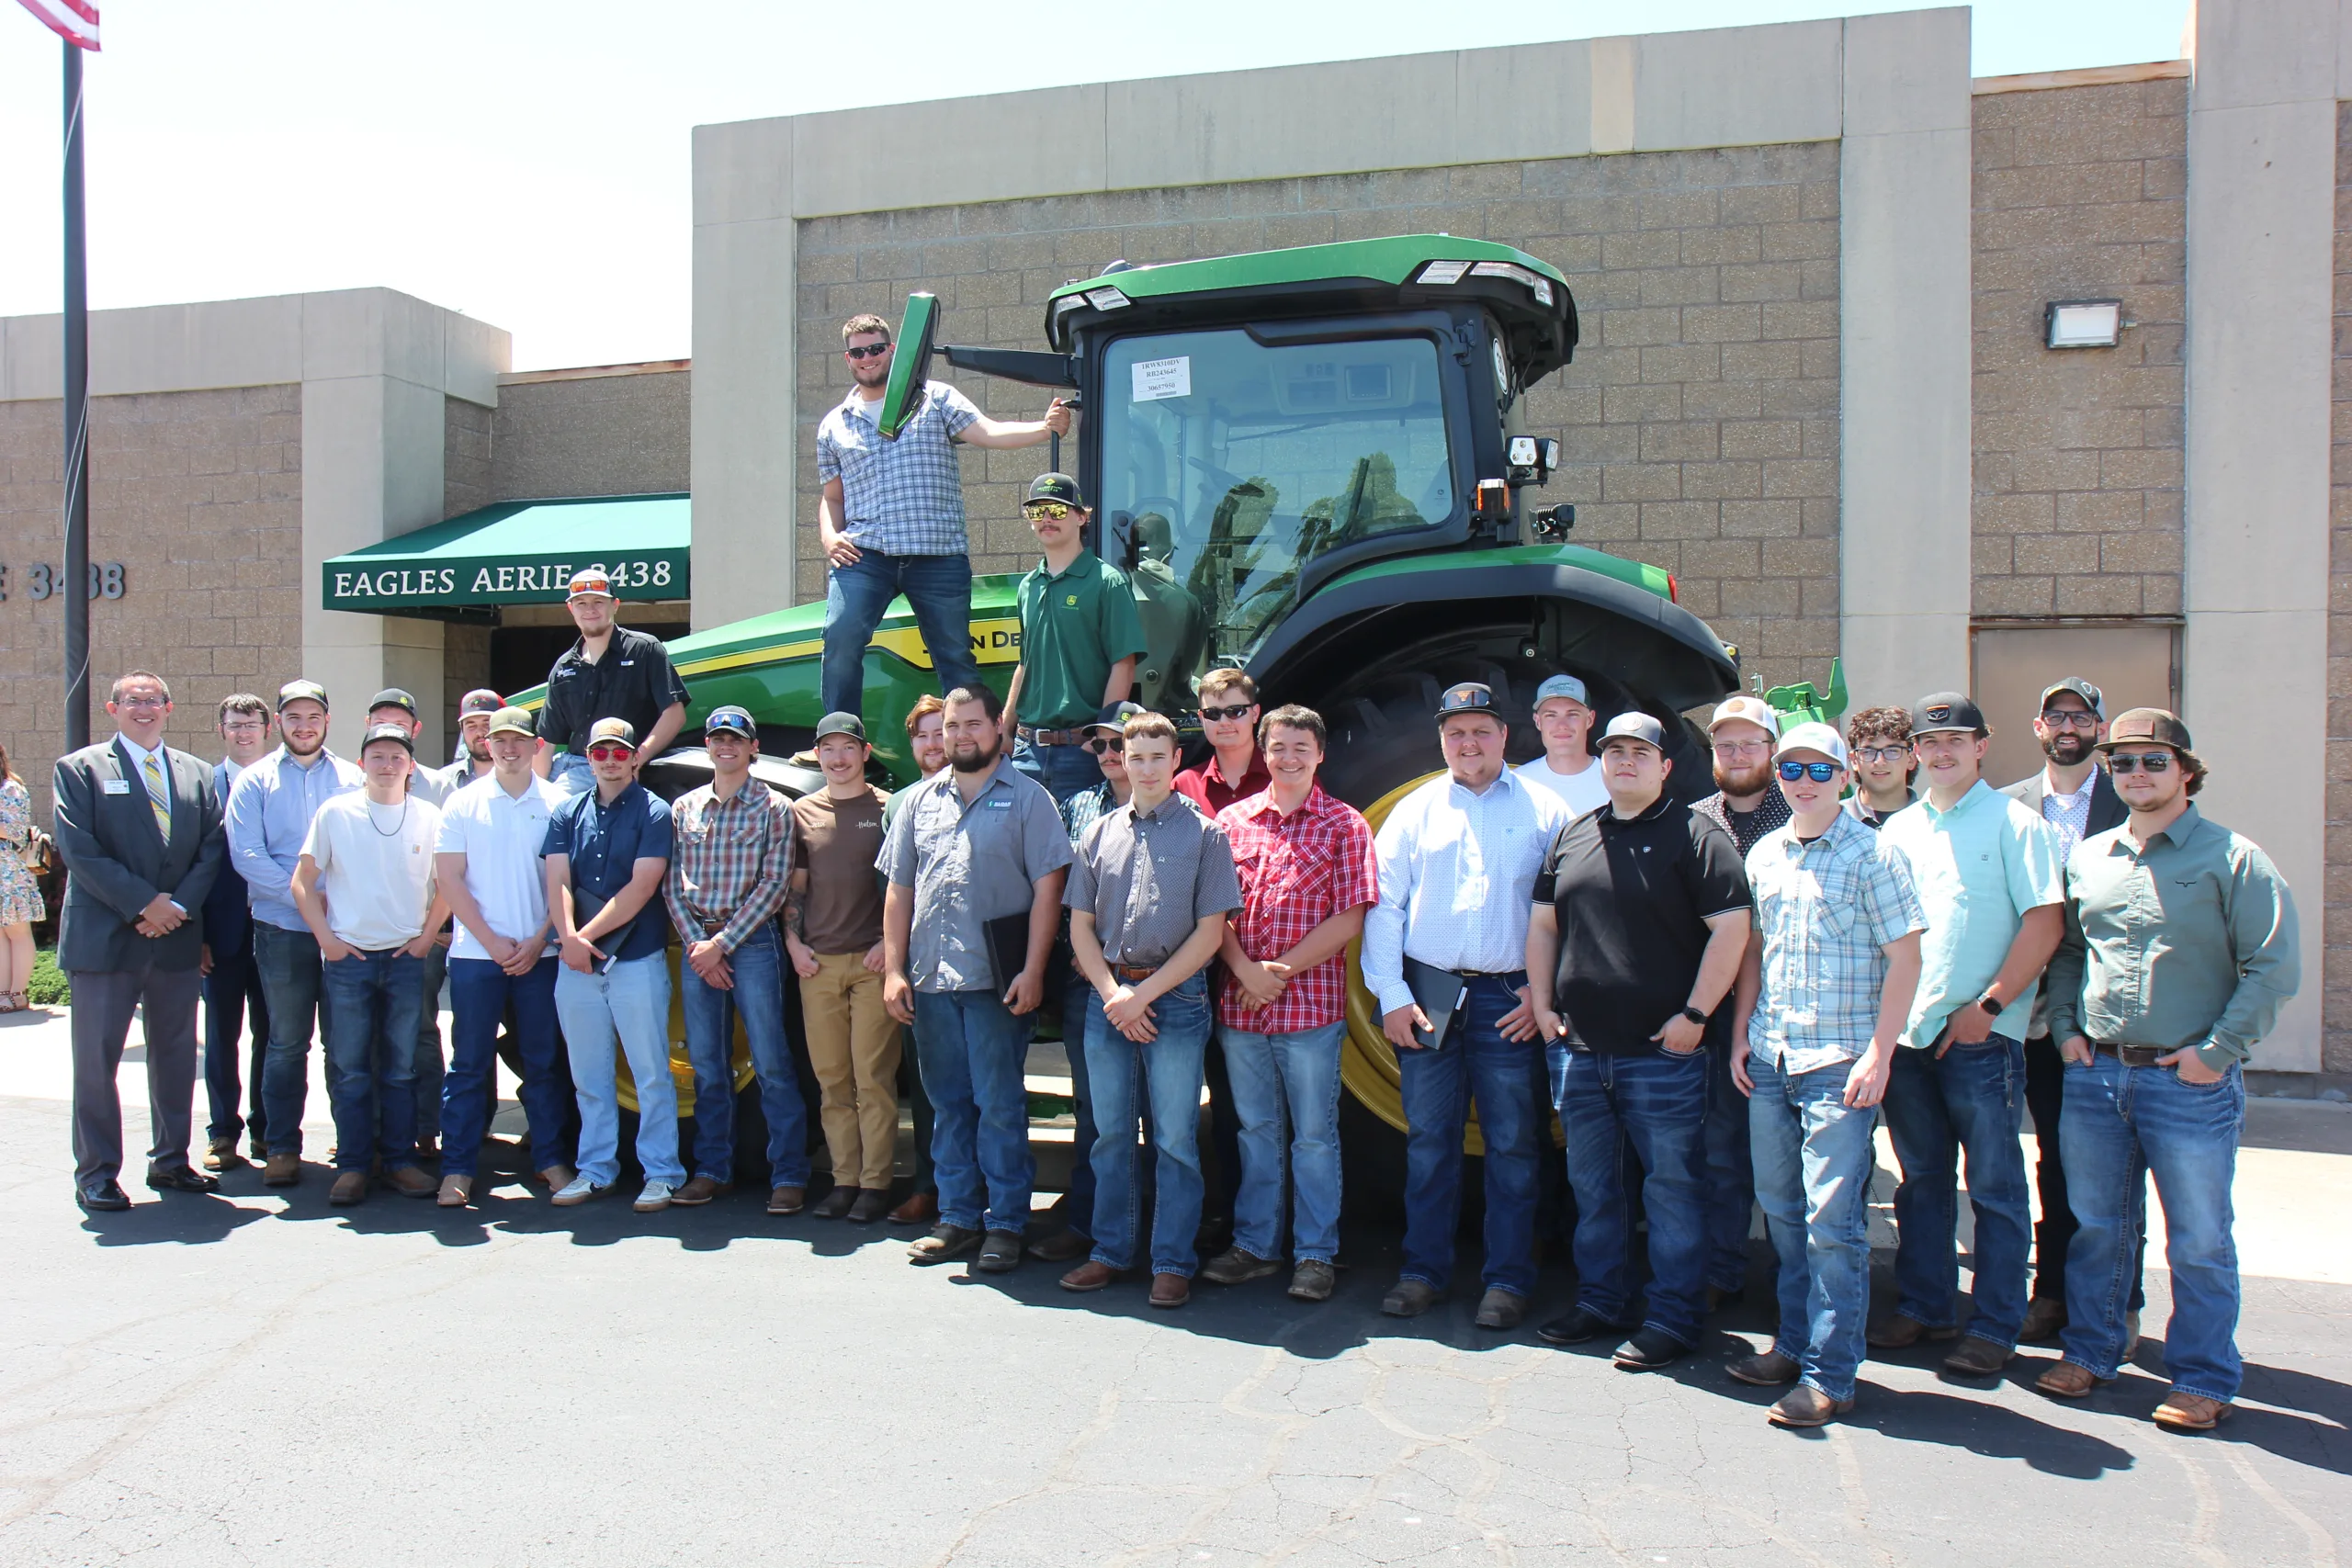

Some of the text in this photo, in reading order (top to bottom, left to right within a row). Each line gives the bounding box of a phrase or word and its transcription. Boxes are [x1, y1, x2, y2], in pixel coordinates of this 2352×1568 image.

[1147, 382, 1176, 392] 30657950
[334, 568, 456, 597] EAGLES
[471, 564, 572, 593] AERIE
